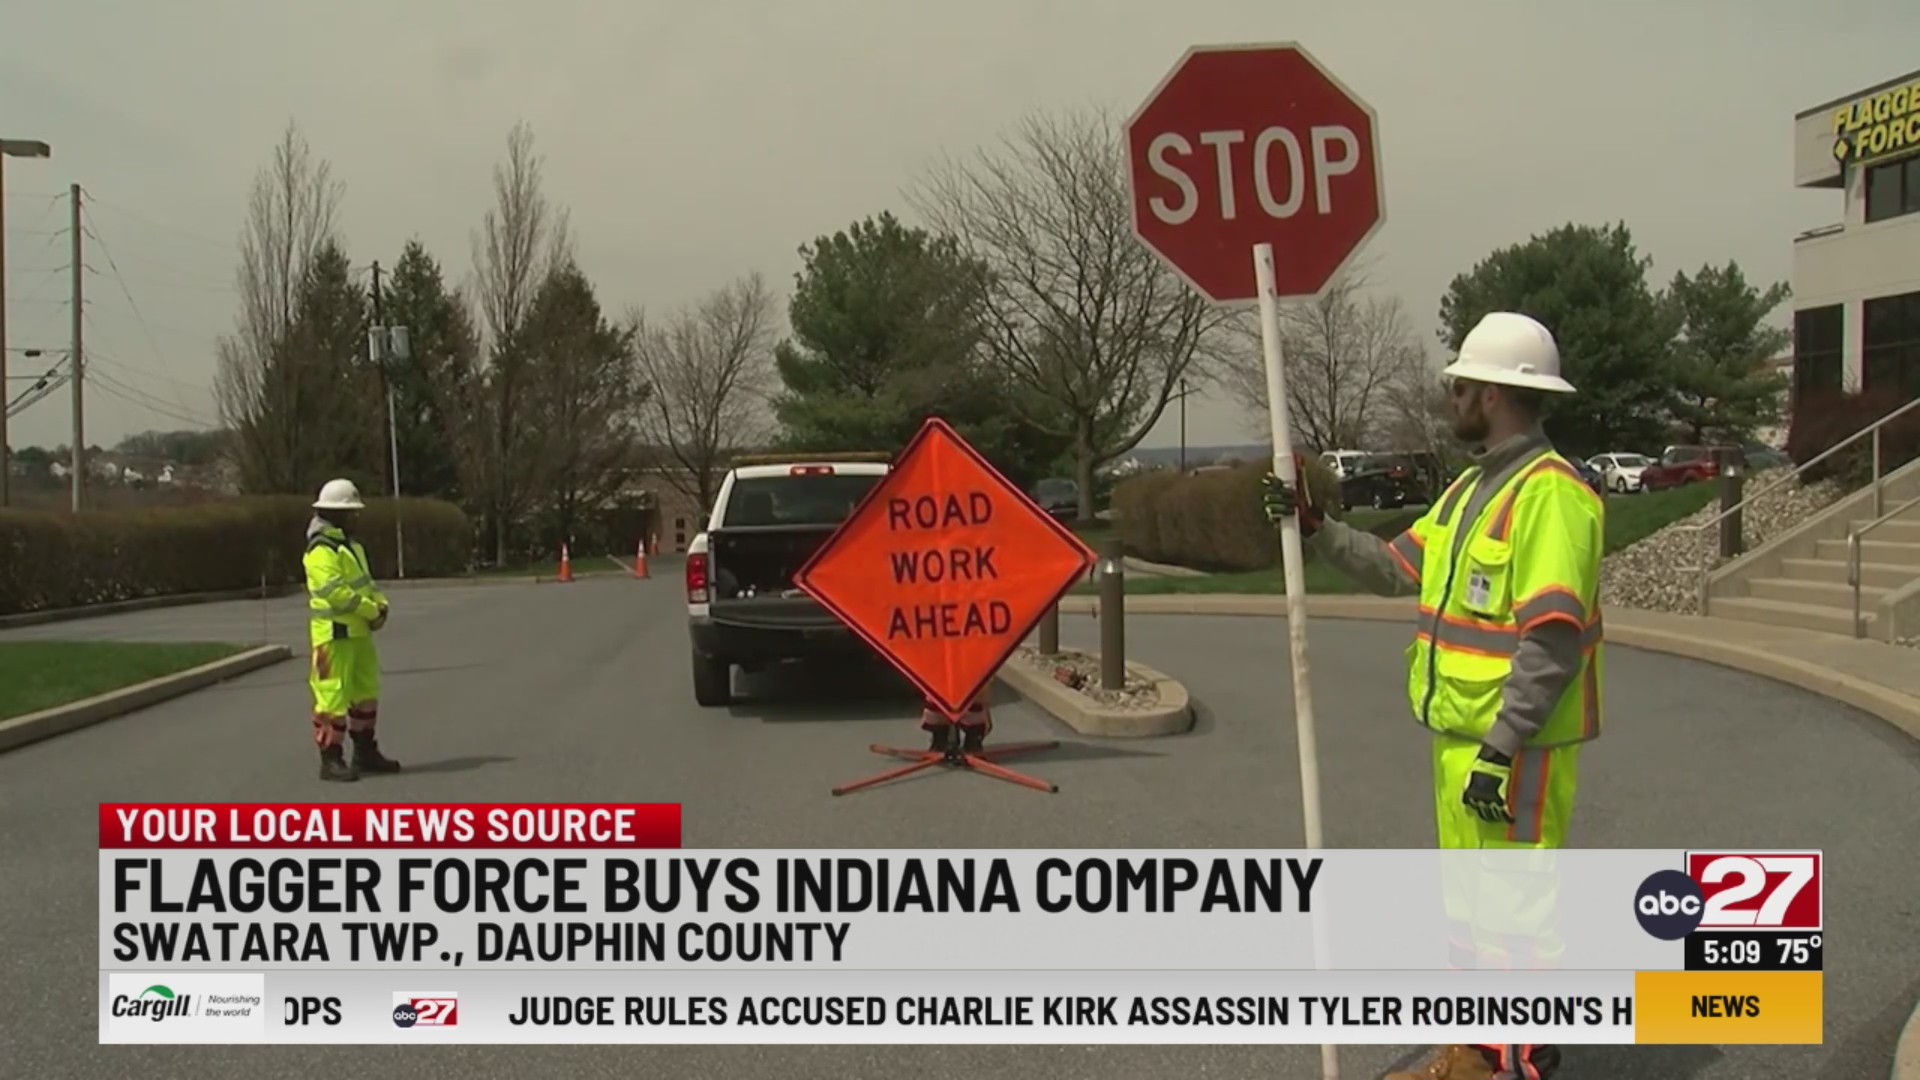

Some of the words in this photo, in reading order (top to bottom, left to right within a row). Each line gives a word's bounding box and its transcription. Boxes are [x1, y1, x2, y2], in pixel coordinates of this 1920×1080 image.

[1855, 113, 1920, 157] FORC
[1147, 125, 1360, 225] STOP
[889, 492, 992, 530] ROAD
[891, 547, 998, 584] WORK
[888, 601, 1012, 640] AHEAD
